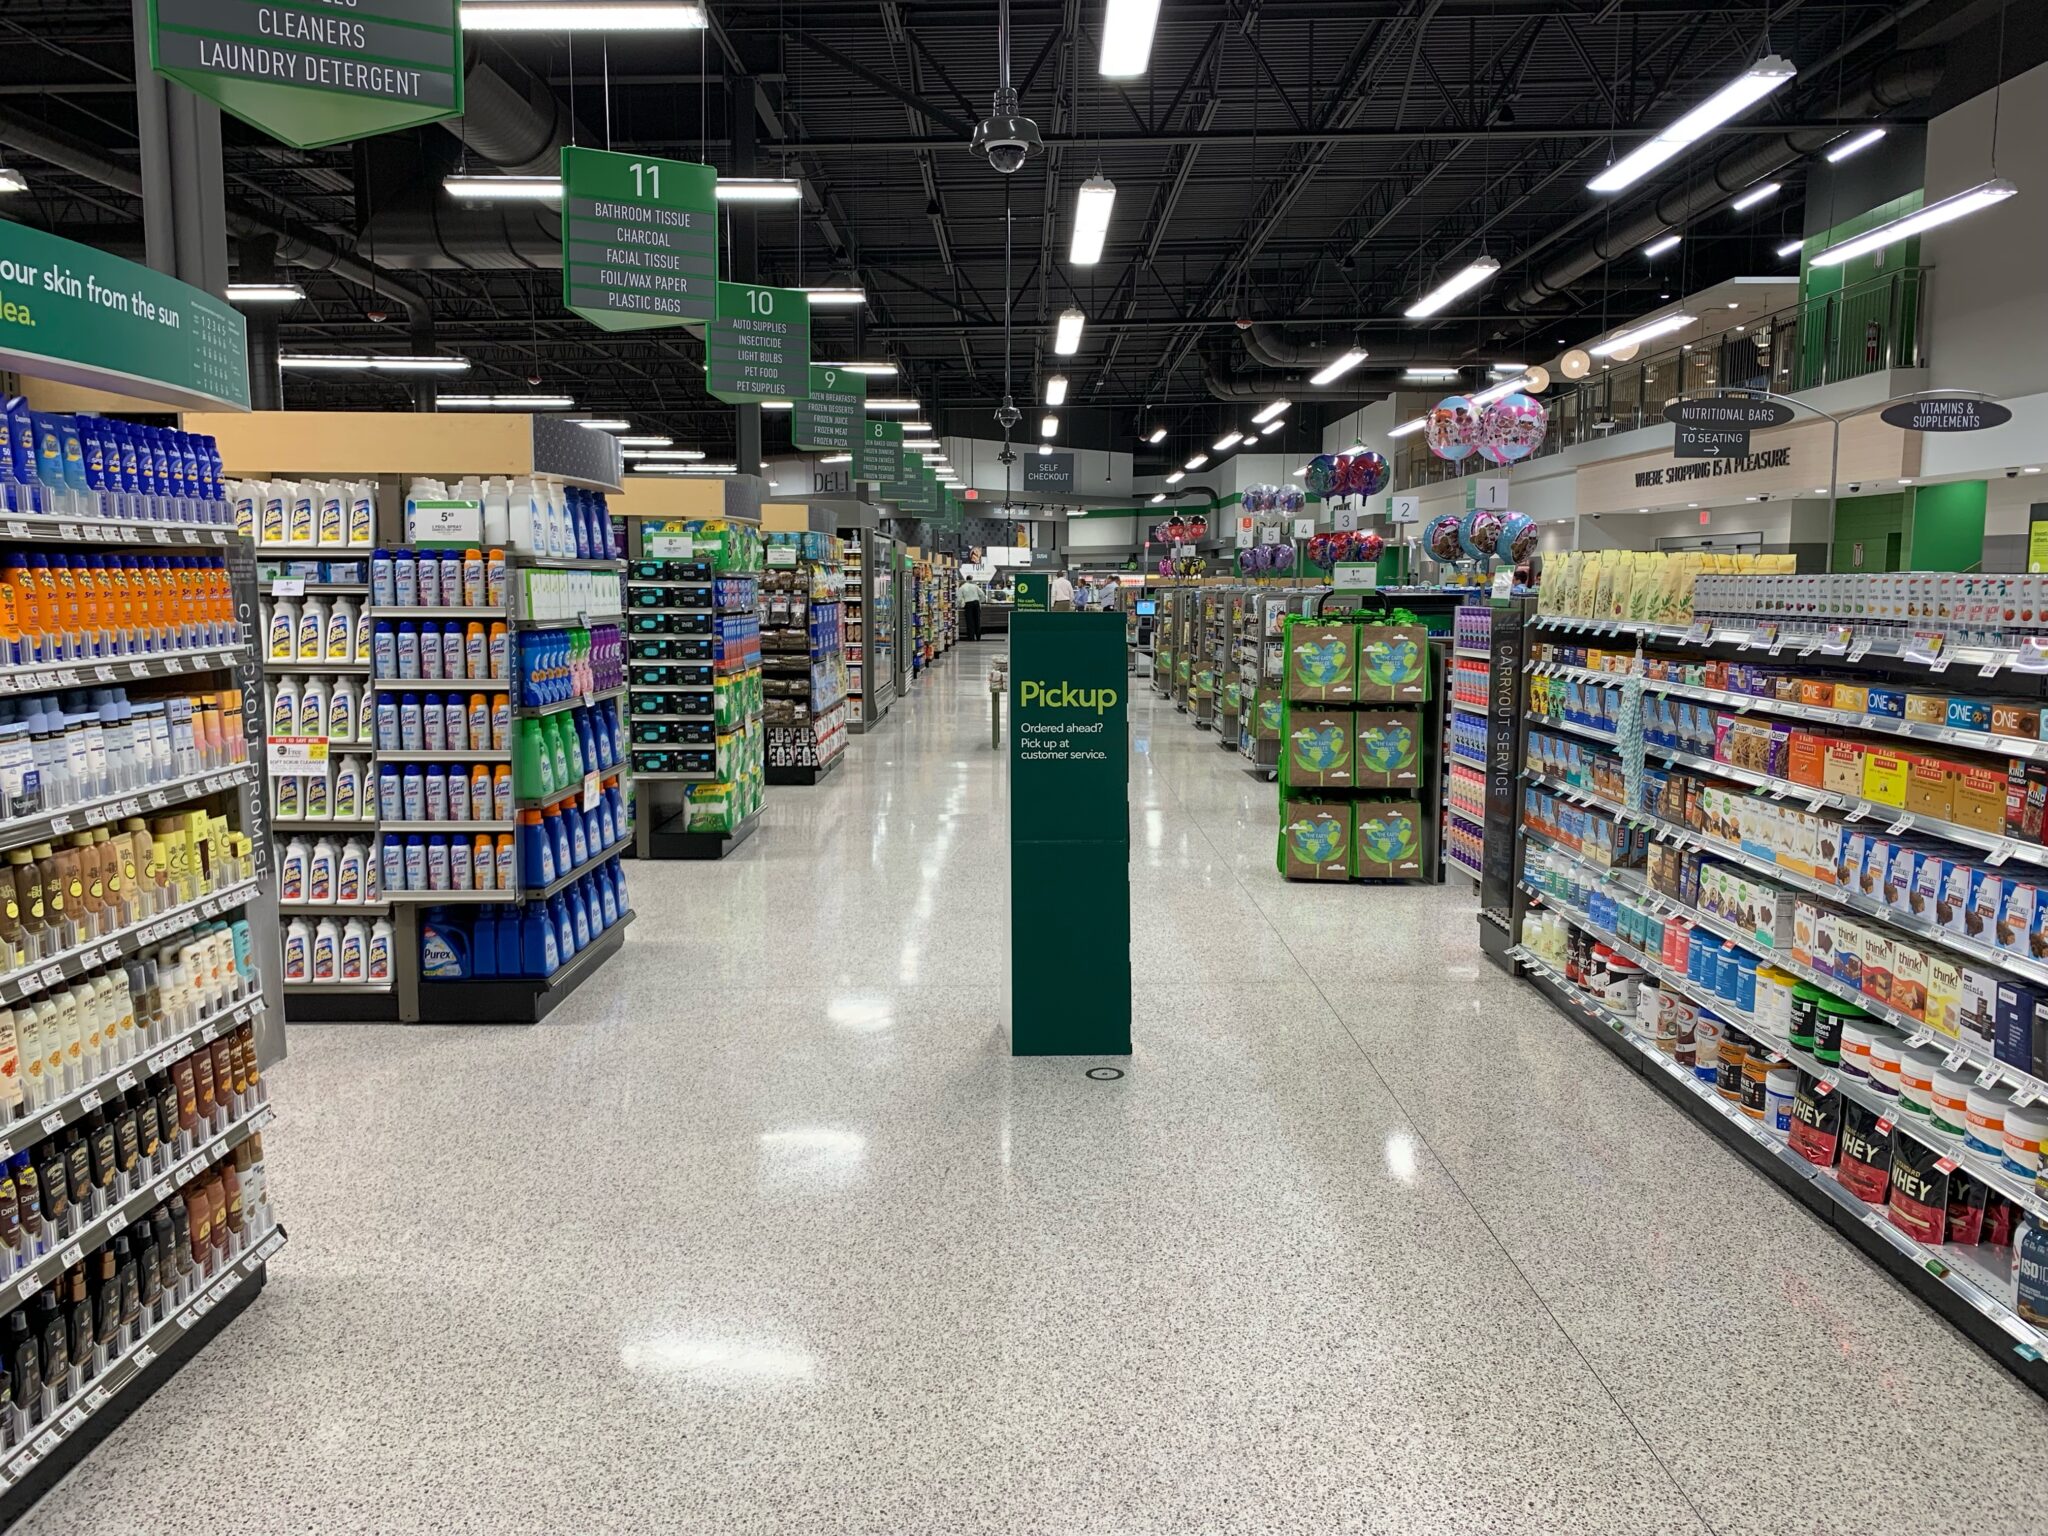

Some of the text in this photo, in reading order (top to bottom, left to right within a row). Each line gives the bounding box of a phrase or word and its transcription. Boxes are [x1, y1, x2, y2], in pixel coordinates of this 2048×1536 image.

[258, 9, 365, 49] CLEANERS
[200, 40, 421, 97] LAUNDRY DETERGENT
[629, 163, 660, 199] 11
[595, 203, 691, 228] BATHROOM TISSUE
[617, 228, 671, 248] CHARCOAL
[606, 249, 681, 270] FACIAL TISSUE
[600, 270, 688, 293] FOIL/WAX PAPER
[44, 264, 83, 300] skin
[87, 275, 129, 313] from
[131, 291, 156, 321] the
[158, 311, 181, 329] sun
[608, 293, 682, 314] PLASTIC BAGS
[746, 290, 774, 316] 10
[732, 318, 787, 335] AUTO SUPPLIES
[738, 335, 782, 349] INSECTICIDE
[738, 351, 783, 364] LIGHT BULBS
[744, 366, 779, 379] PET FOOD
[825, 371, 836, 389] 9
[736, 381, 785, 395] PET SUPPLIES
[825, 394, 857, 403] BREAKFASTS
[808, 403, 854, 414] FROZEN DESSERTS
[1682, 408, 1774, 422] NUTRITIONAL BARS
[1920, 402, 1974, 415] VITAMINS &
[813, 415, 849, 425] FROZEN JUICE
[1913, 415, 1980, 428] SUPPLEMENTS
[814, 426, 848, 436] FROZEN MEAT
[874, 424, 883, 437] 8
[813, 437, 848, 447] FROZEN PIZZA
[1682, 433, 1743, 443] TO SEATING
[1039, 464, 1059, 472] SELF
[1635, 447, 1791, 488] WHERE SHOPPING IS A PLEASURE
[814, 471, 849, 493] DELI
[1028, 472, 1070, 481] CHECKOUT
[1489, 486, 1495, 503] 1
[1401, 502, 1410, 517] 2
[1342, 514, 1350, 528] 3
[1268, 531, 1274, 541] 5
[1300, 525, 1307, 534] 4
[1242, 535, 1248, 545] 6
[1498, 645, 1513, 726] CARRYOUT
[1802, 684, 1820, 700] ONE
[1020, 680, 1118, 715] Pickup
[1836, 688, 1854, 704] ONE
[1868, 694, 1889, 711] ONE
[1907, 697, 1927, 716] ONE
[1948, 703, 1973, 722] ONE
[1992, 709, 2020, 729] ONE
[1020, 723, 1103, 733] Ordered ahead?
[1736, 723, 1749, 732] Quest
[1751, 727, 1767, 736] Quest
[1771, 732, 1788, 741] Quest
[1020, 738, 1070, 750] Pick up at
[1840, 742, 1852, 750] BARS
[1020, 749, 1107, 759] customer service.
[1495, 733, 1510, 796] SERVICE
[1925, 758, 1940, 768] BARS
[1916, 767, 1941, 780] LARABAR
[1975, 769, 1992, 779] BARS
[2008, 767, 2025, 778] KIND
[1966, 779, 1994, 792] LARABAR
[2008, 777, 2027, 785] ENERGY
[2028, 790, 2046, 803] KIND
[249, 763, 268, 880] PROMISE
[1838, 925, 1857, 943] think!
[424, 949, 450, 960] Purex
[1865, 938, 1887, 957] think!
[1899, 952, 1922, 972] think!
[1933, 967, 1958, 988] think!
[1963, 983, 1984, 997] minis
